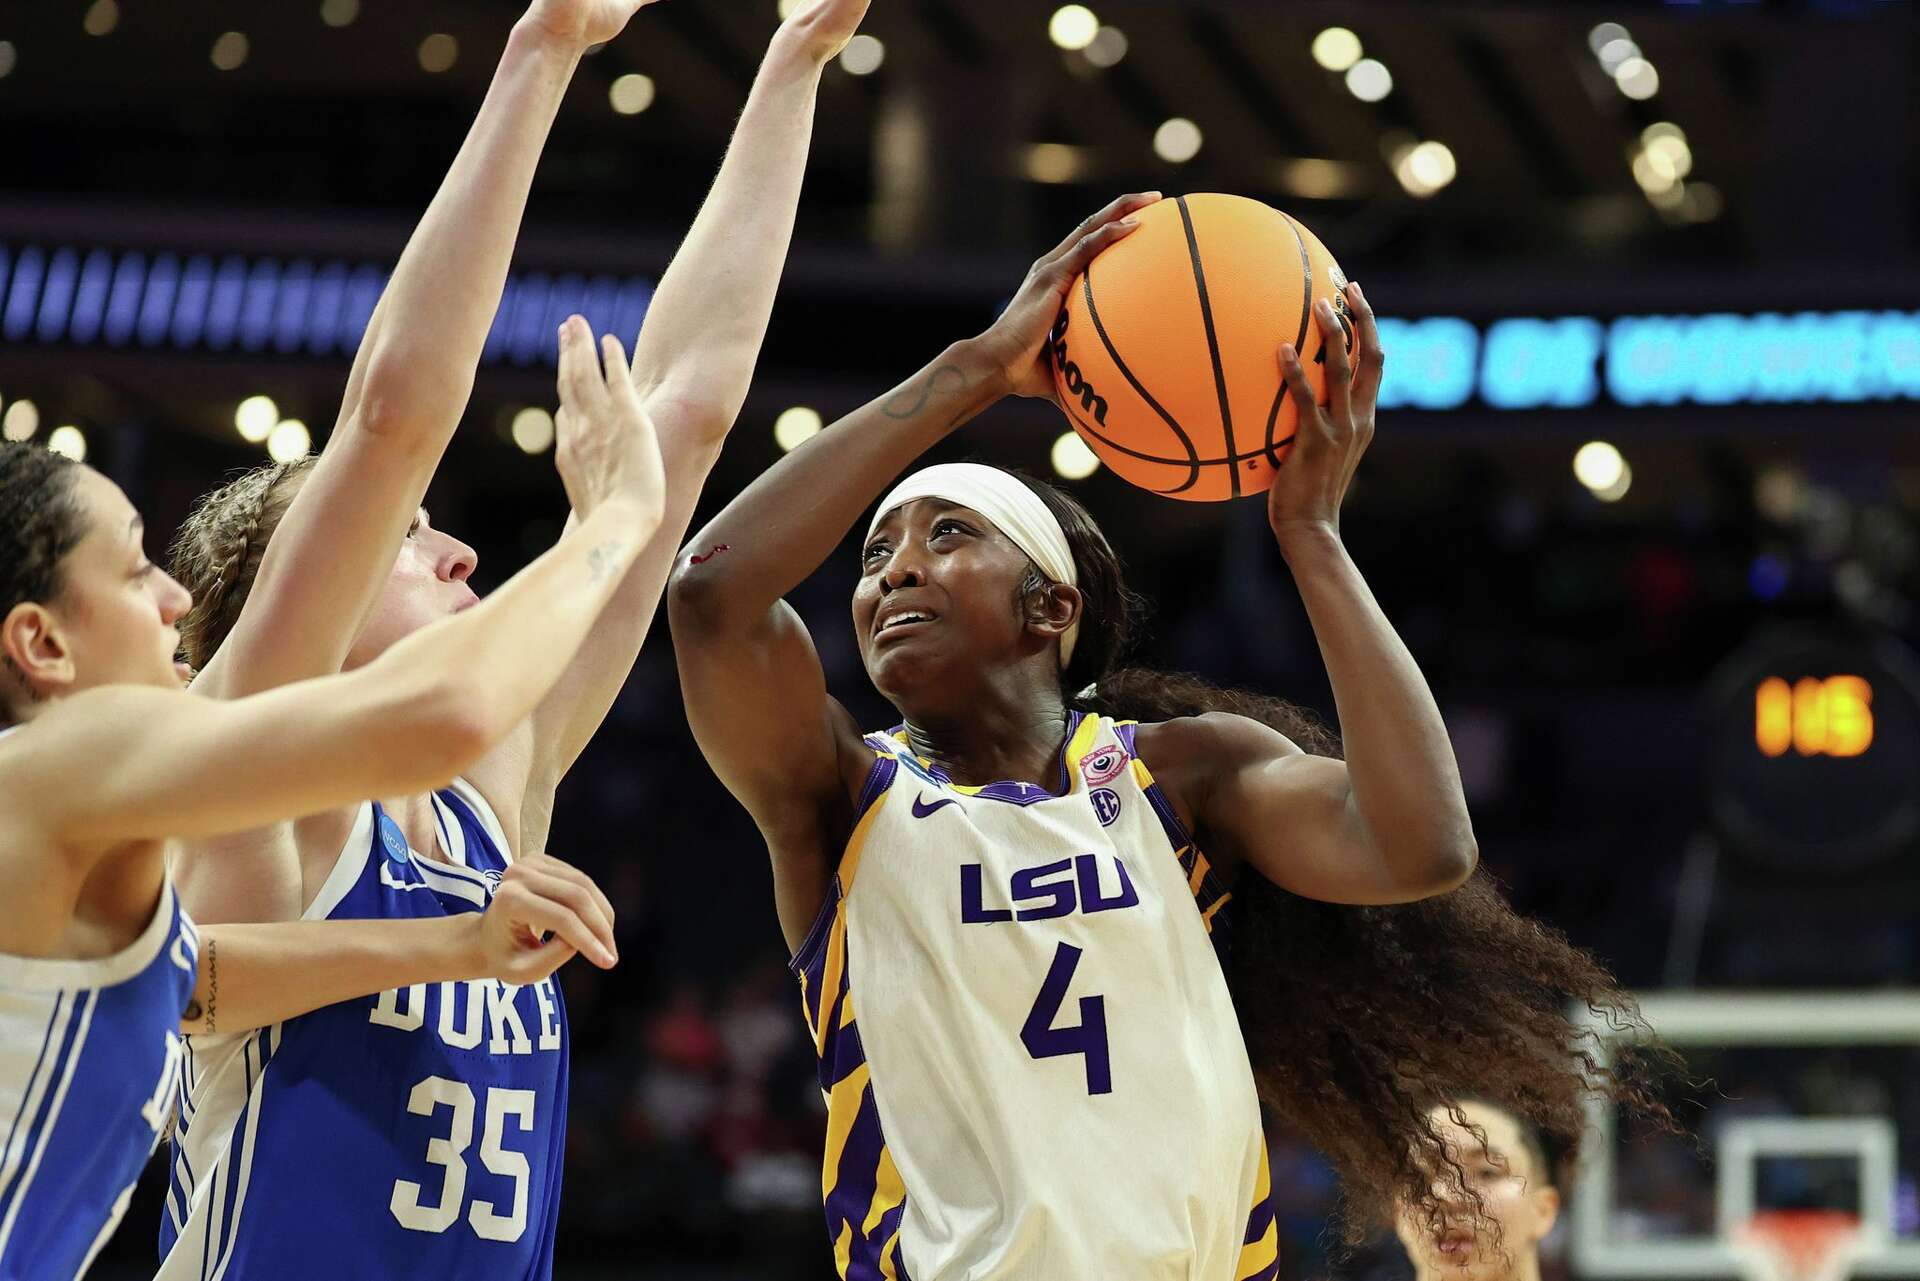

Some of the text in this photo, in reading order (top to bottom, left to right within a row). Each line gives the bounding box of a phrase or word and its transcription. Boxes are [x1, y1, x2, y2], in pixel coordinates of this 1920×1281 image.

[960, 853, 1140, 924] LSU
[369, 976, 561, 1055] DUKE
[1019, 941, 1113, 1096] 4
[389, 1074, 537, 1243] 35
